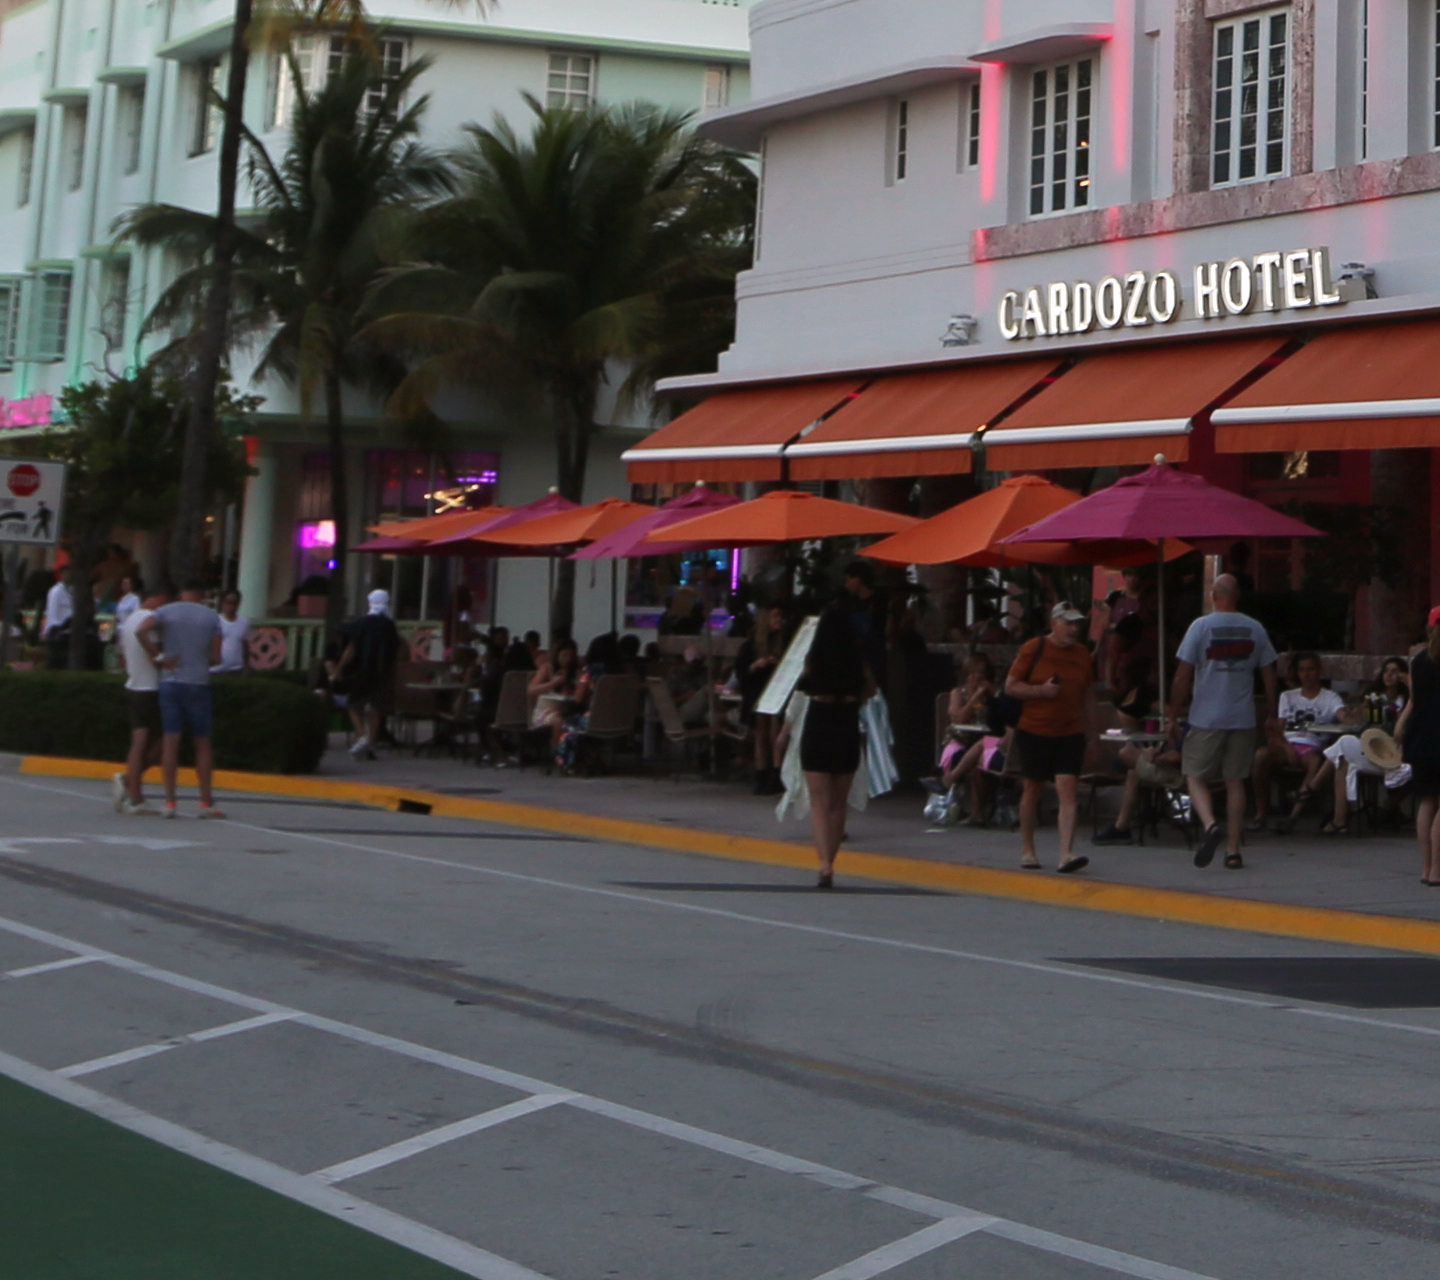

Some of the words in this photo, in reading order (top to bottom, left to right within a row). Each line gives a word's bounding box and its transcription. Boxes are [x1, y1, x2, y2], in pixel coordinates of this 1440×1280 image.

[1000, 269, 1181, 340] CARDOZO
[1194, 246, 1341, 315] HOTEL
[8, 473, 39, 487] STOP
